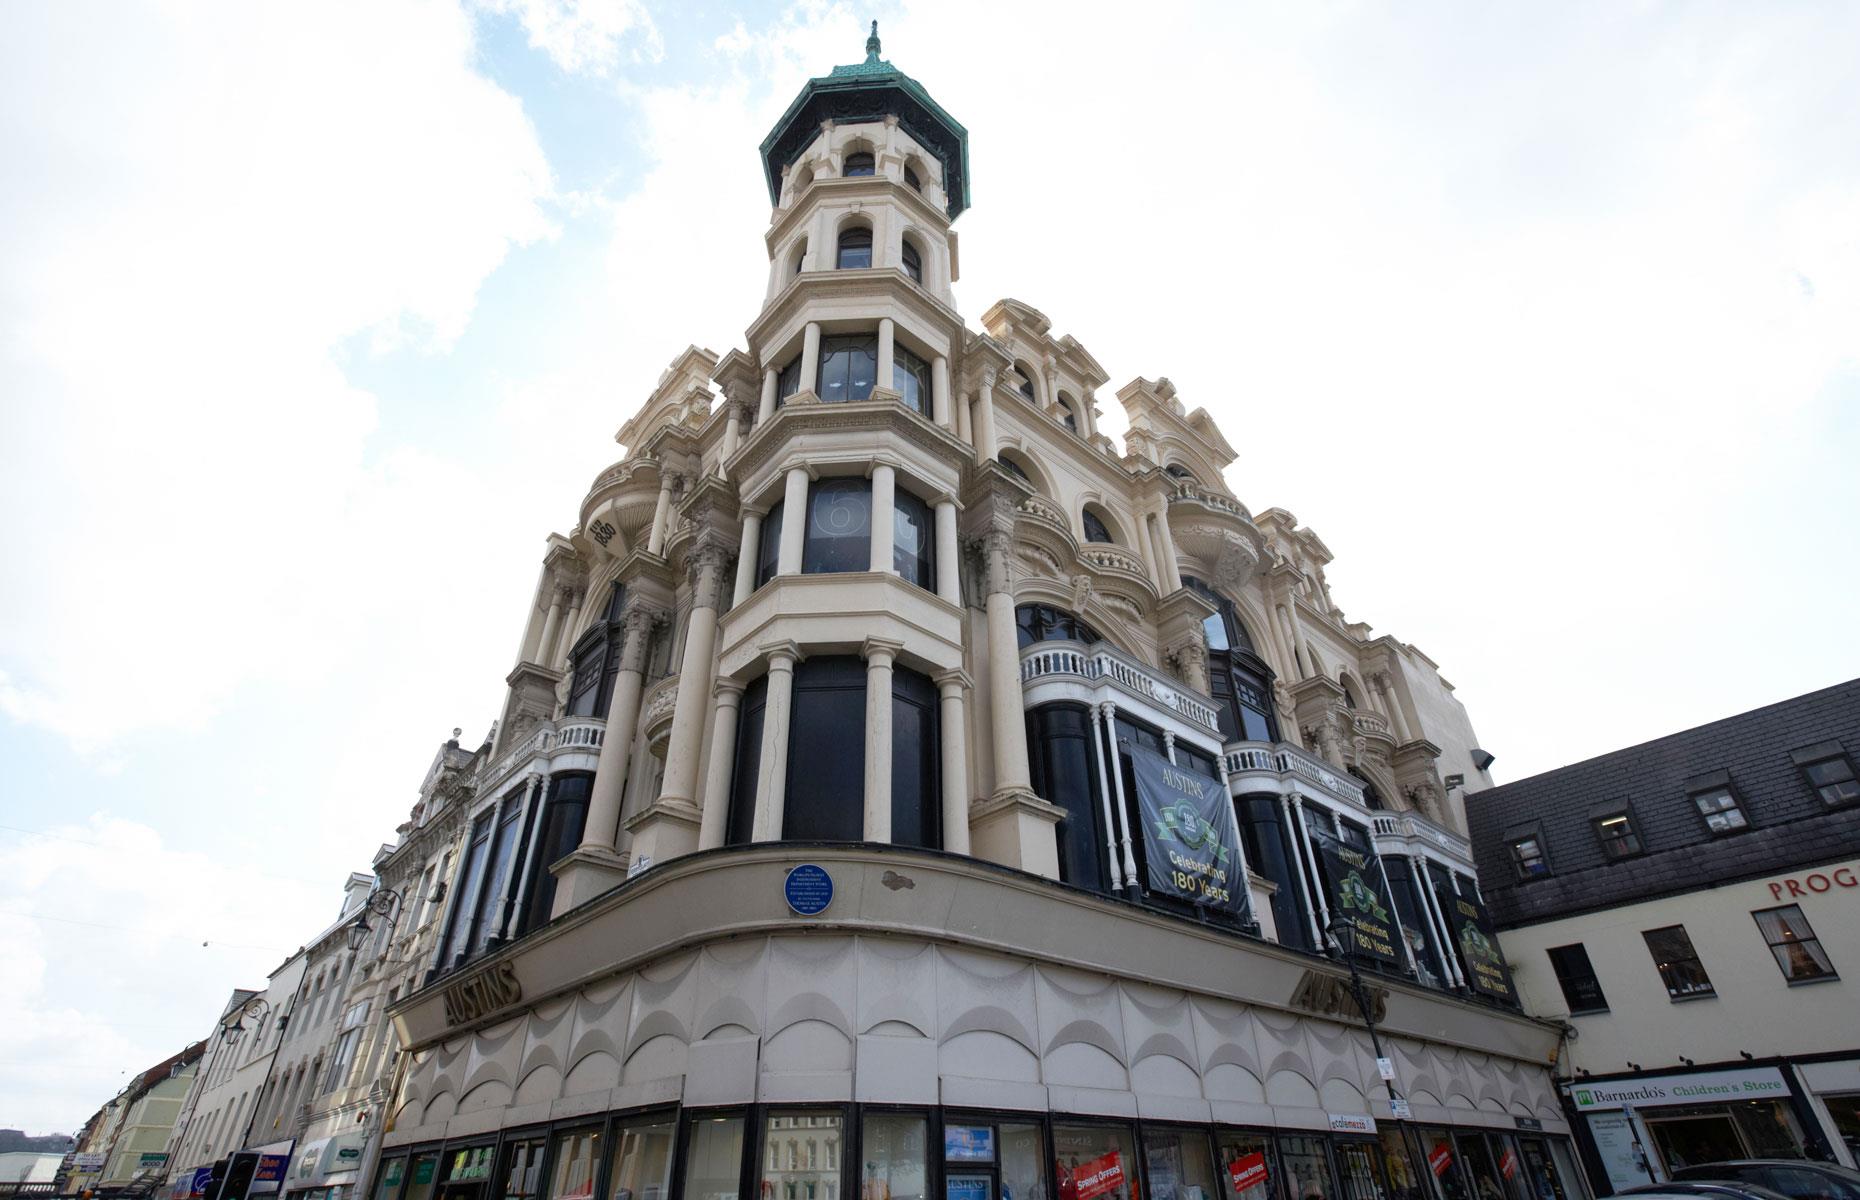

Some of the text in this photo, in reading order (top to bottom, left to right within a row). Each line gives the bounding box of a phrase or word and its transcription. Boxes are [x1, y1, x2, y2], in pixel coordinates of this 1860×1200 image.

[594, 522, 616, 548] 1830
[1162, 767, 1205, 800] AUSTINS
[1169, 850, 1227, 884] Celebrating
[1338, 846, 1367, 871] AUSTINS
[1171, 870, 1231, 902] 180 Years
[1355, 932, 1395, 957] 180 Years
[443, 960, 522, 1028] AUSTINS
[1594, 1079, 1783, 1105] Barnardo's Children's Store
